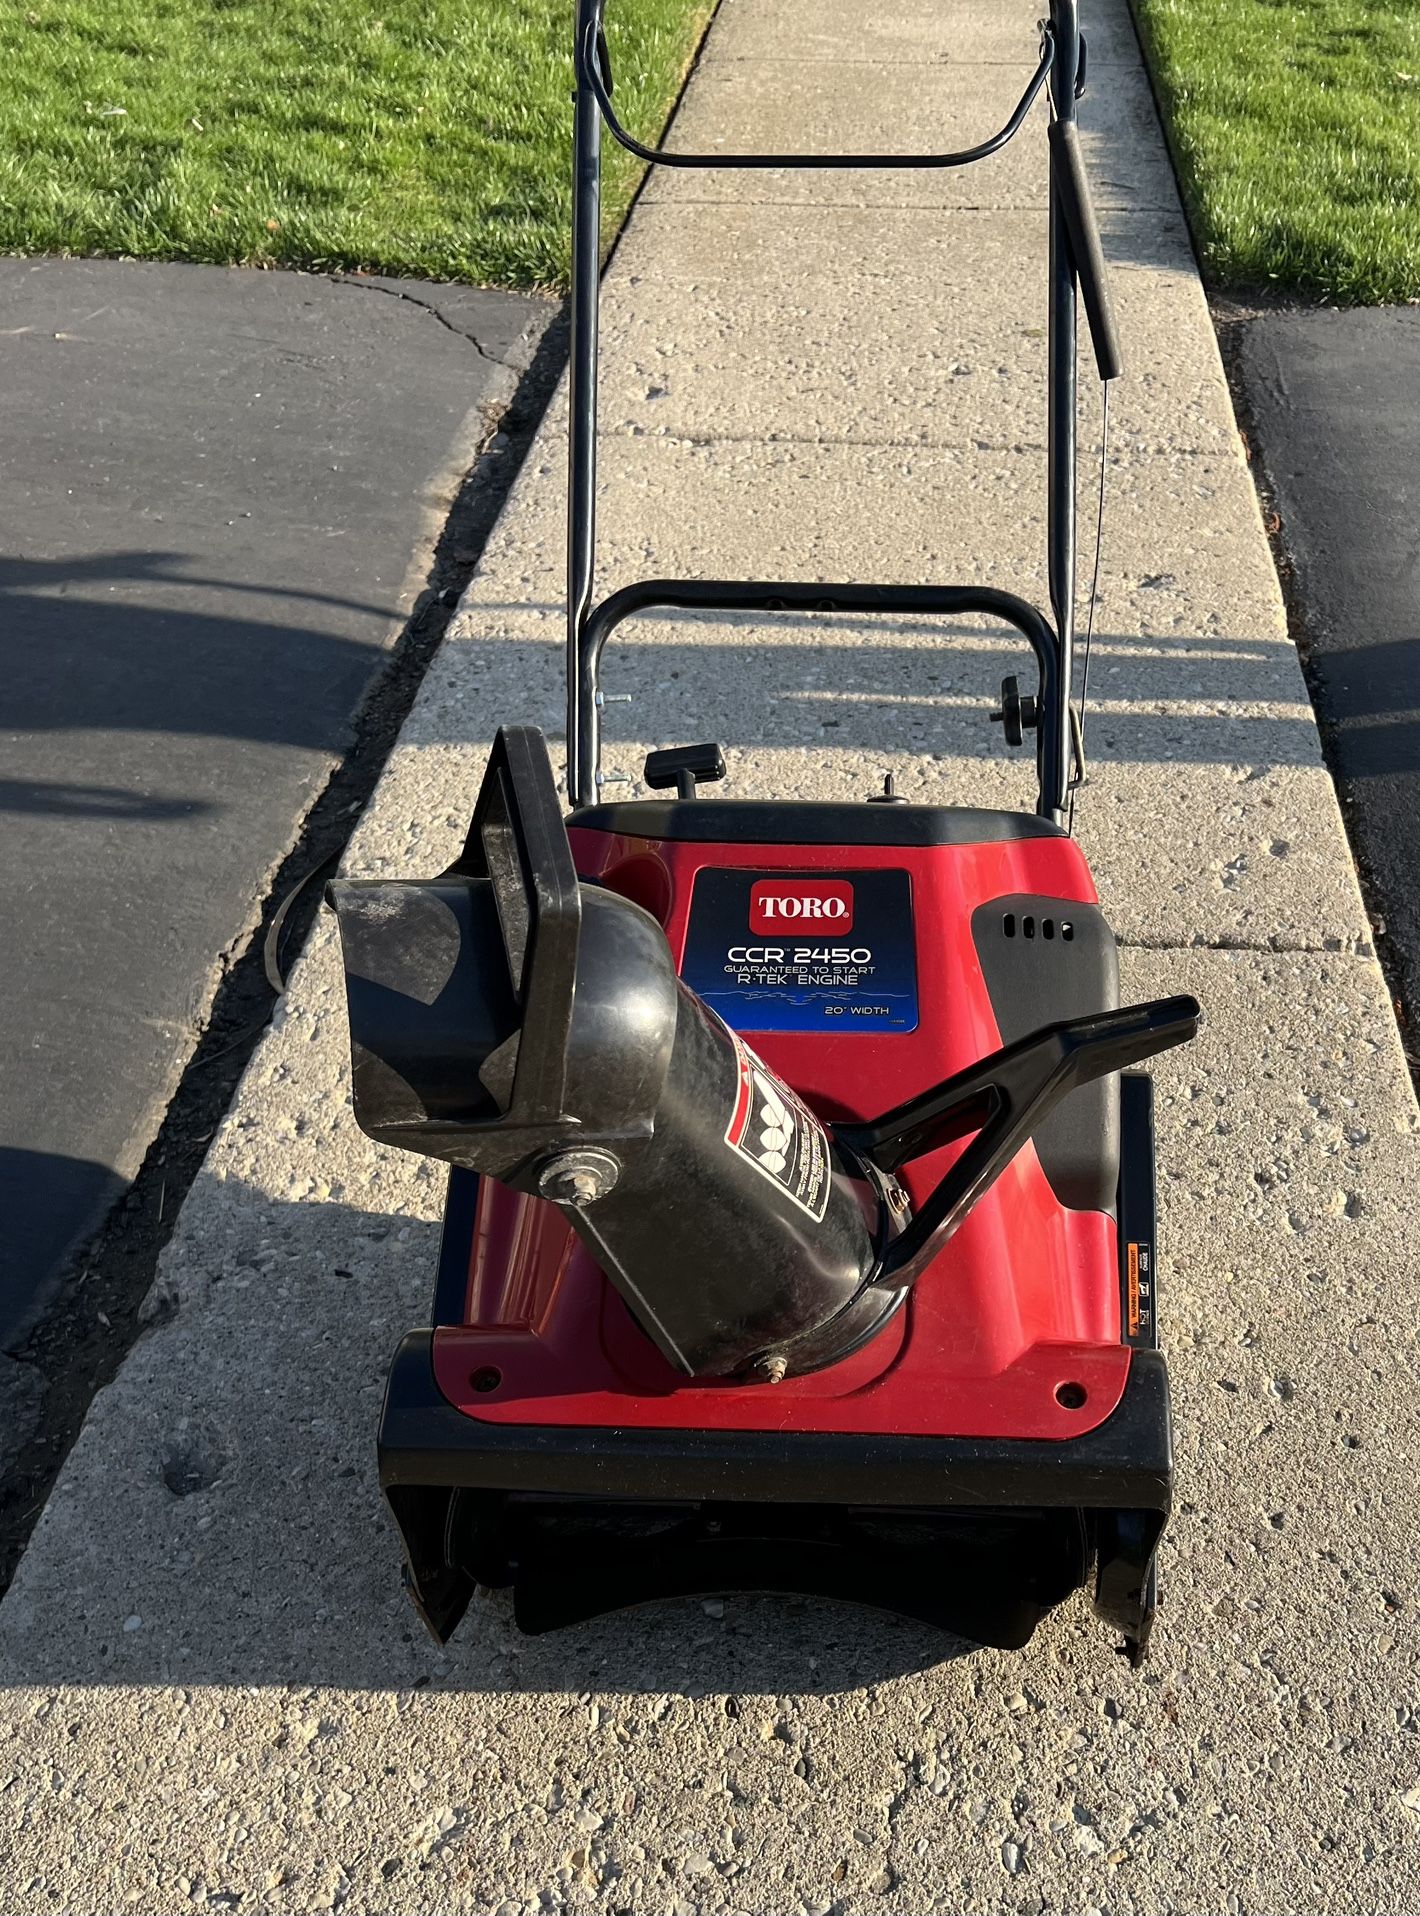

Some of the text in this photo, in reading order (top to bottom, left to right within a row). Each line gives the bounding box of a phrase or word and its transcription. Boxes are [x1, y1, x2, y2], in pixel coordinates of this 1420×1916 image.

[758, 896, 846, 918] TORO
[793, 947, 872, 964] 2450
[723, 965, 876, 975] GUARANTEED TO START
[797, 975, 859, 986] ENGINE
[850, 1006, 889, 1015] WIDTH
